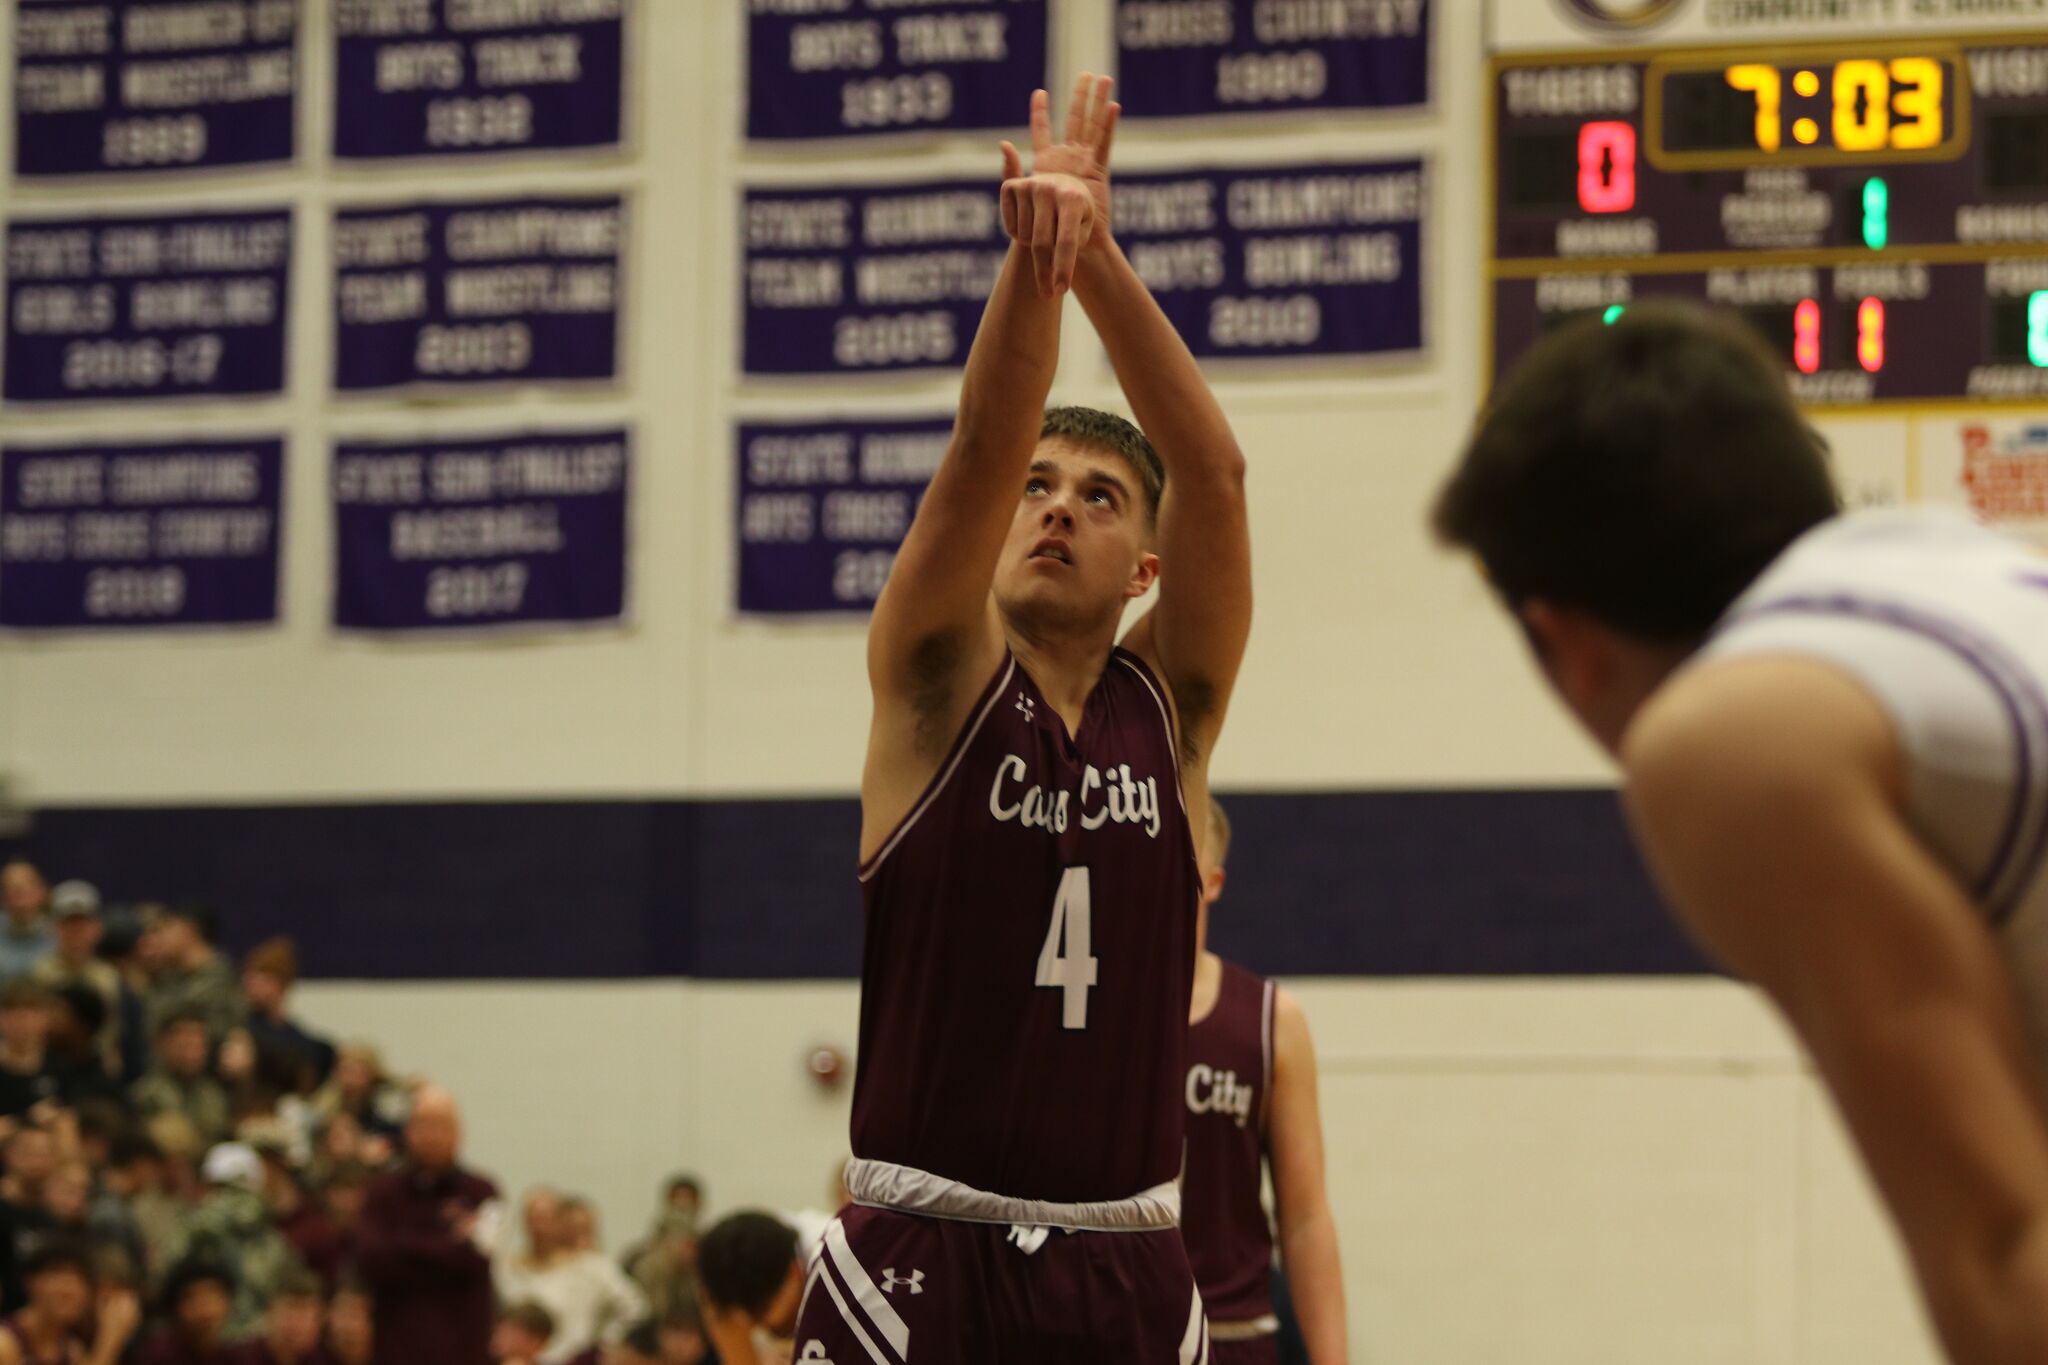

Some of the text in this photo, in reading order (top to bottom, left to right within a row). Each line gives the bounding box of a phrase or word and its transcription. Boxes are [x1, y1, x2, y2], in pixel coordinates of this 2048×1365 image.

[1506, 67, 1638, 114] TIGERS
[1724, 57, 1943, 152] 7:03
[1577, 121, 1636, 213] 0
[1863, 175, 1888, 250] 1
[1081, 763, 1161, 839] City
[1035, 866, 1098, 1029] 4
[1185, 1063, 1252, 1128] City
